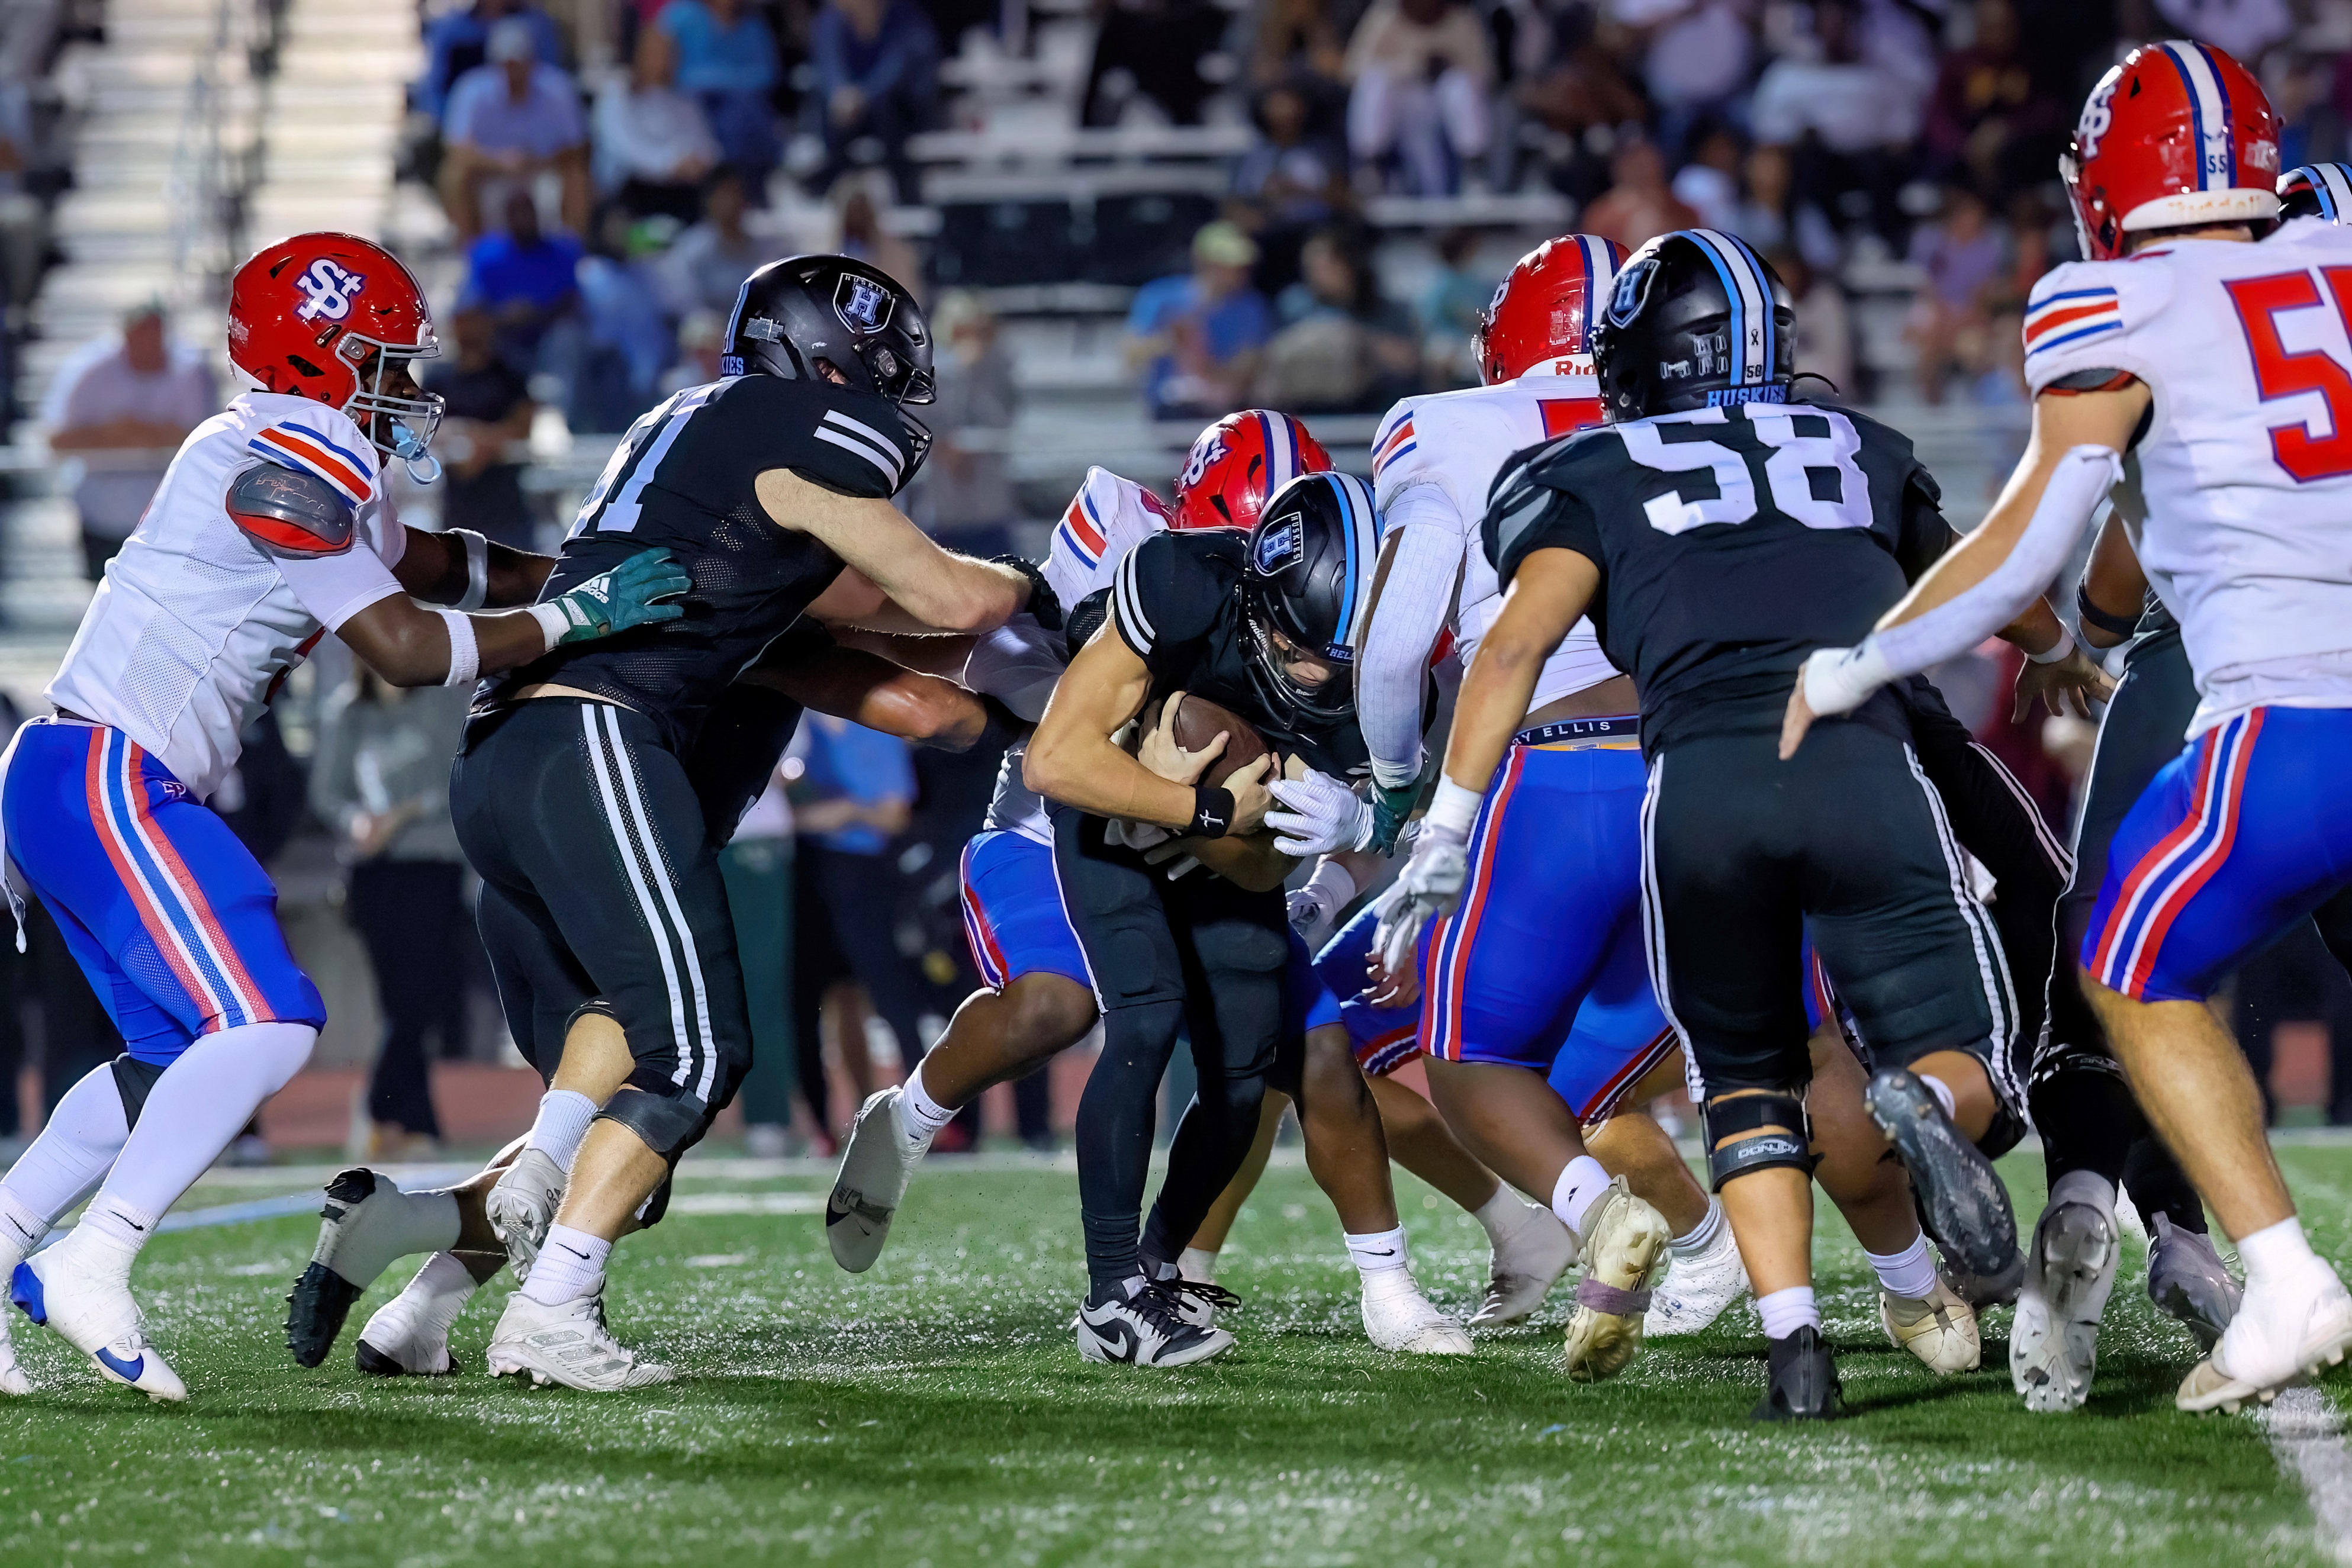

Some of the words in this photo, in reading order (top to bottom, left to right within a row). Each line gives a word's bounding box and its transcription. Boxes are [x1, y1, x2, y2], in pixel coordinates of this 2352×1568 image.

[845, 283, 883, 325] H
[1614, 271, 1644, 313] H
[2220, 266, 2352, 484] 5
[1614, 401, 1874, 536] 58
[1262, 524, 1293, 567] H
[1291, 516, 1301, 560] HUSKIES
[1329, 648, 1354, 661] HEL
[1543, 722, 1611, 738] ELLIS
